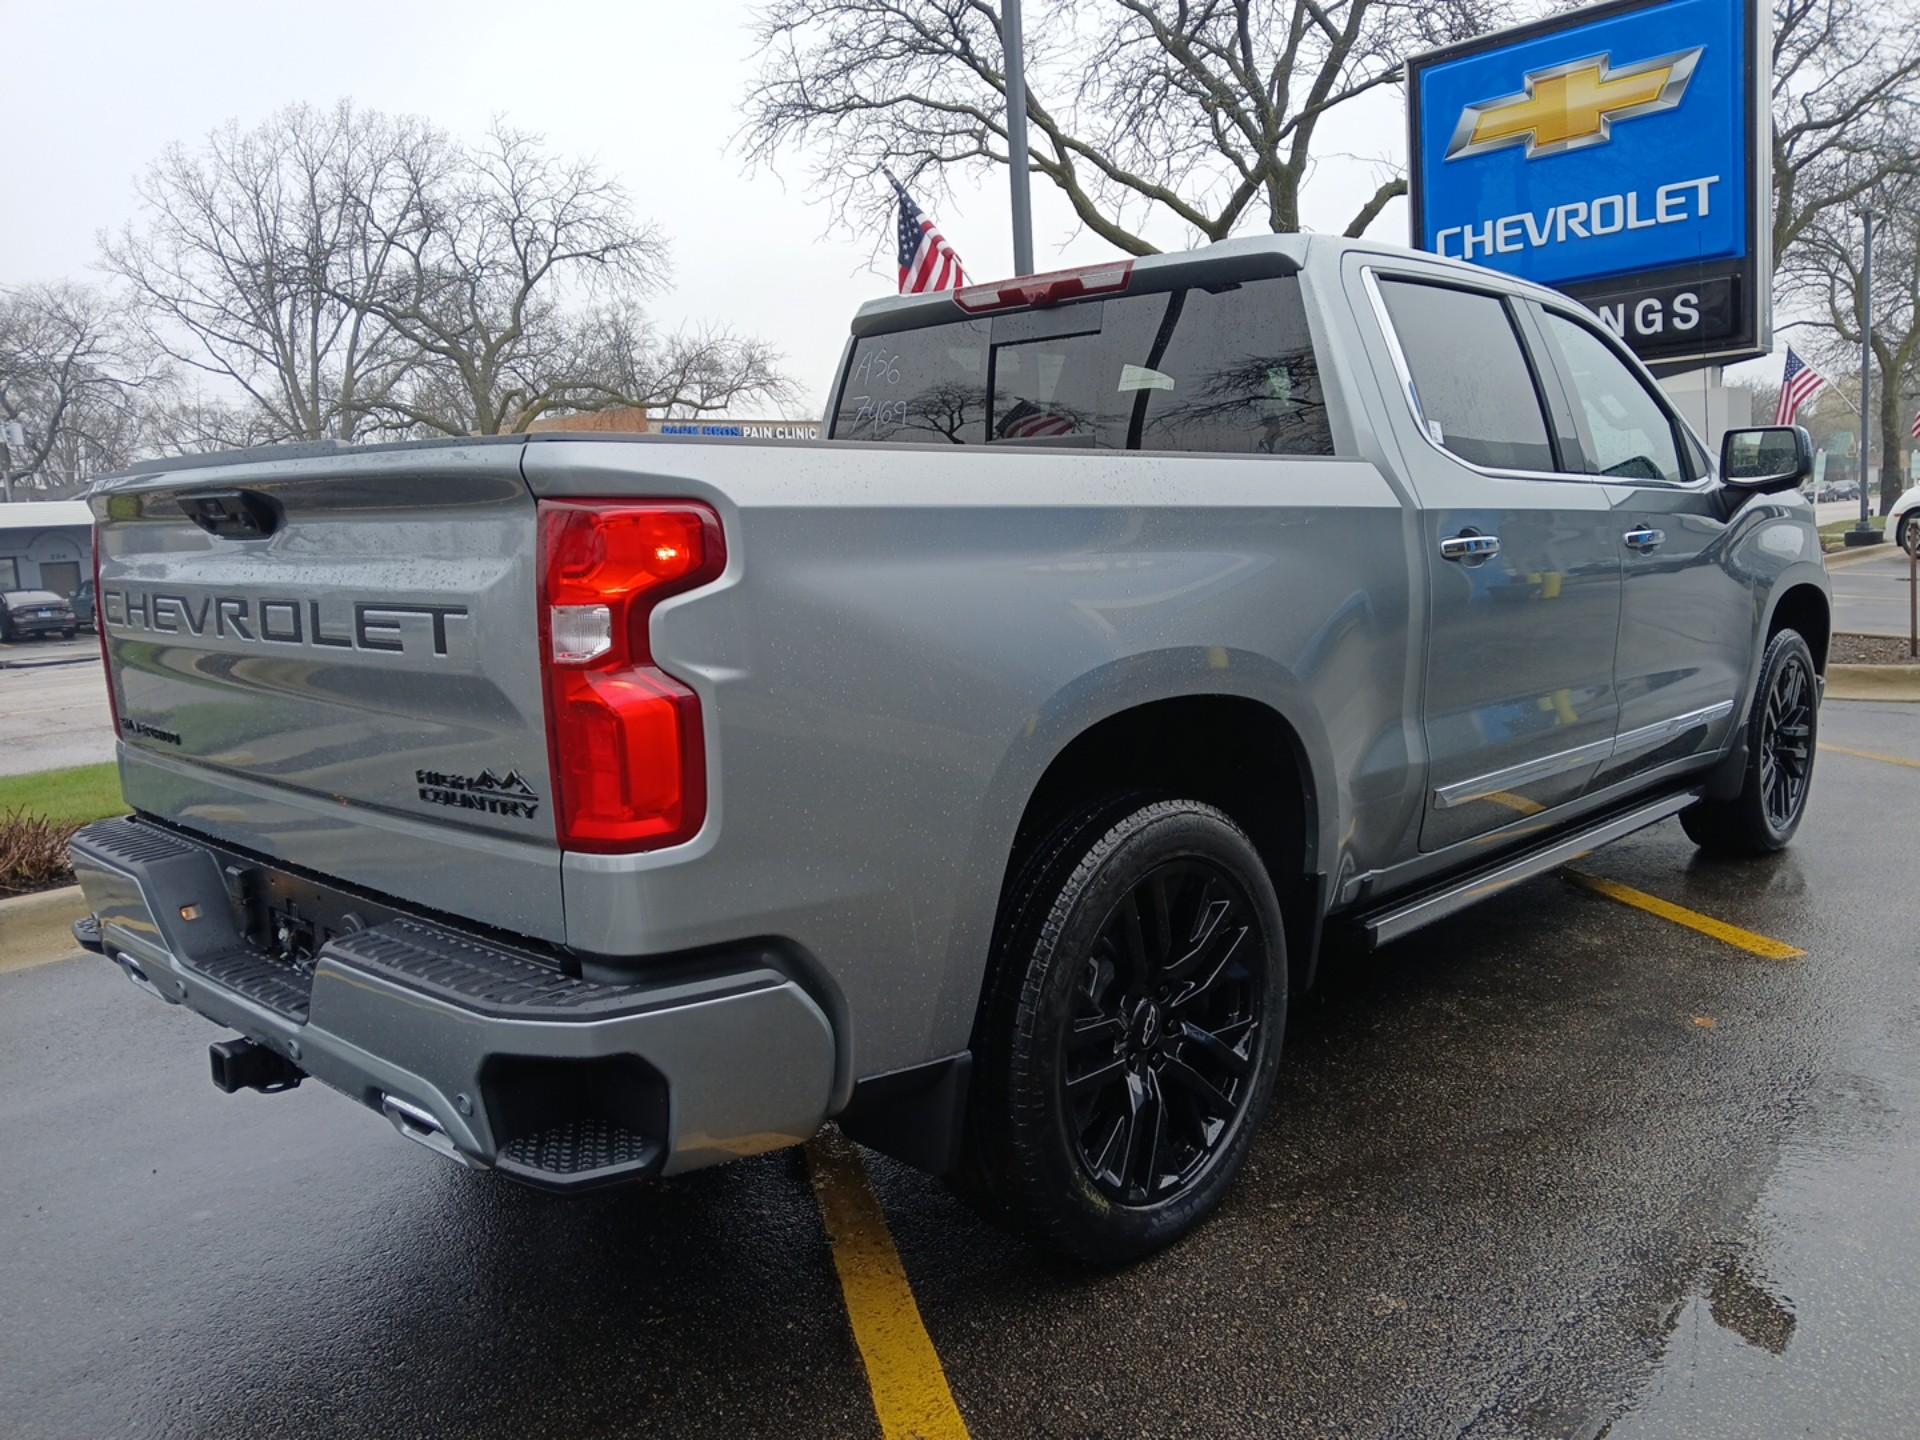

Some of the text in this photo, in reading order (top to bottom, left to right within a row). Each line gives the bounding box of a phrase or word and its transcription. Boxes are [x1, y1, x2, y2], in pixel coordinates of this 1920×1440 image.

[1436, 175, 1720, 261] CHEVROLET
[850, 395, 906, 433] 7469
[743, 427, 773, 438] PAIN
[775, 428, 817, 440] CLINIC
[104, 591, 468, 657] CHEVROLET
[418, 788, 539, 819] COUNTRY
